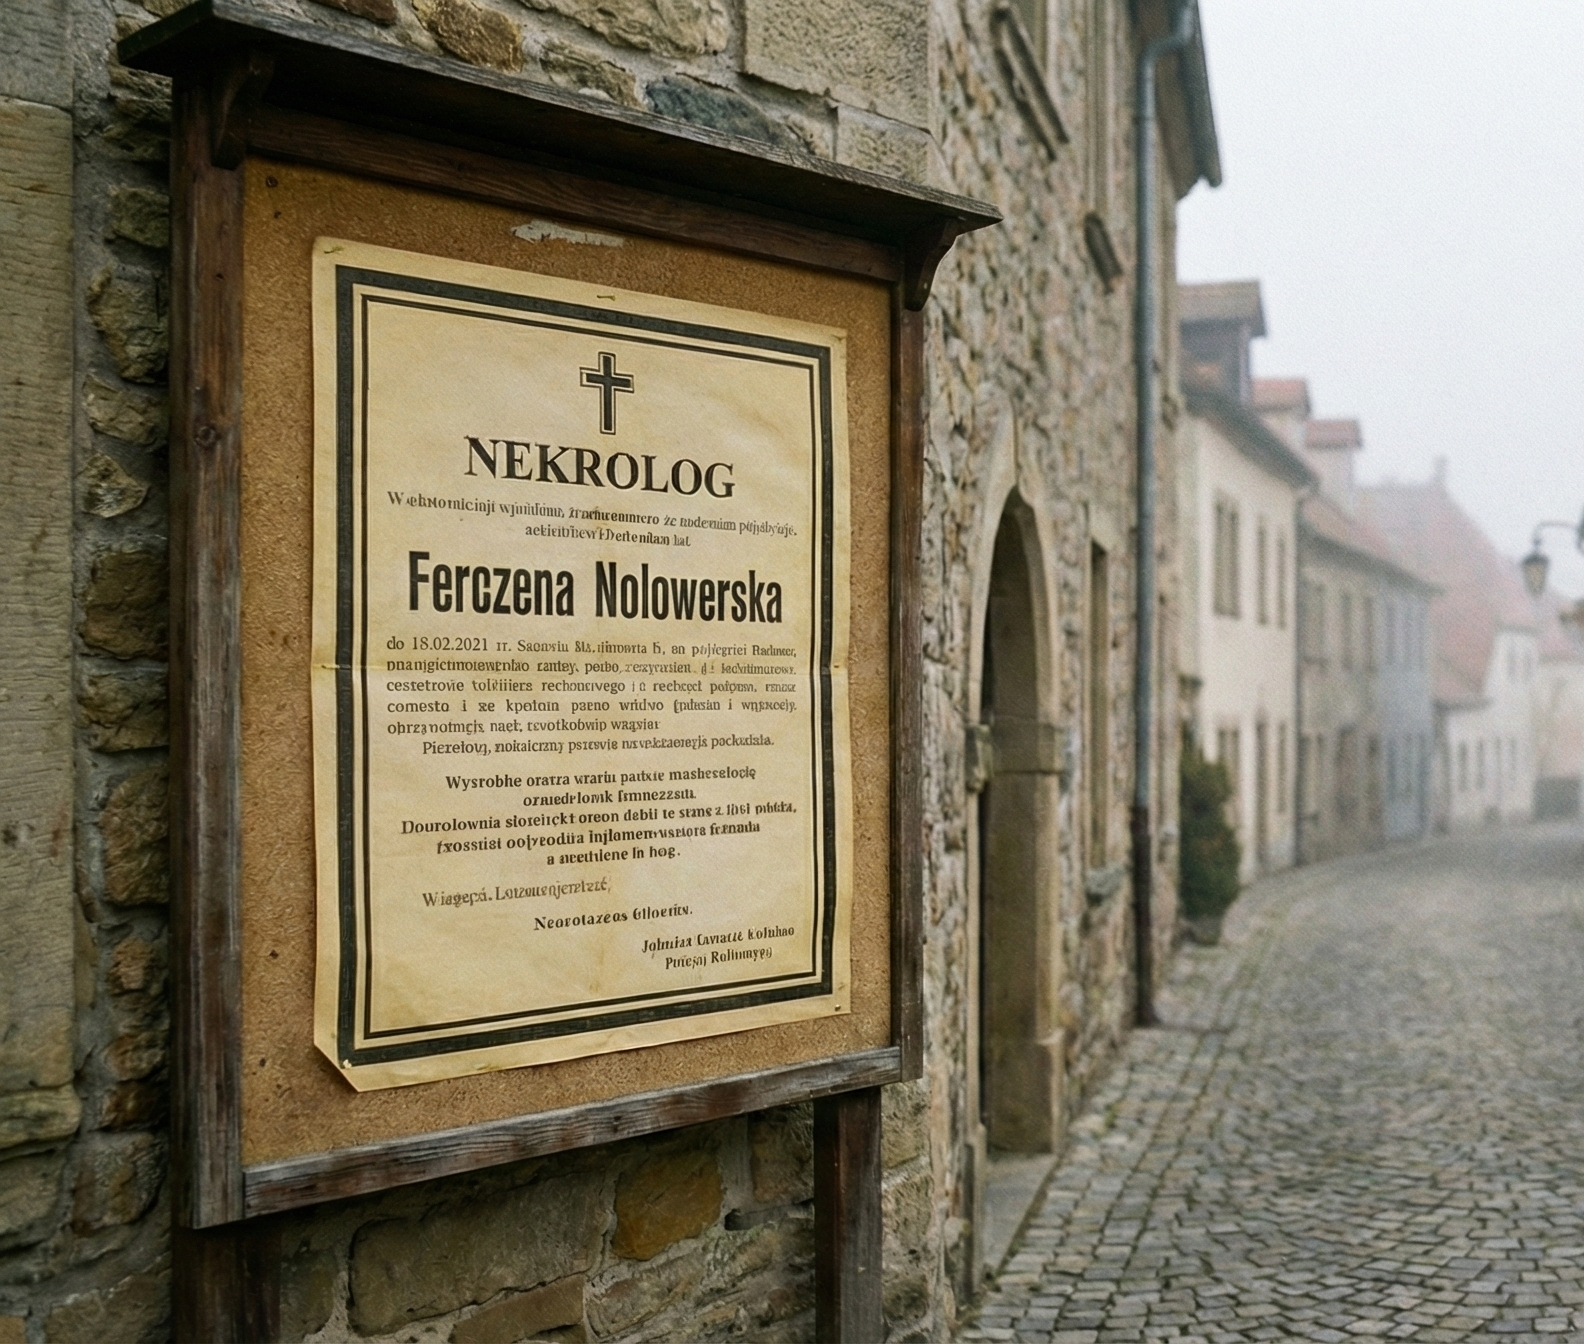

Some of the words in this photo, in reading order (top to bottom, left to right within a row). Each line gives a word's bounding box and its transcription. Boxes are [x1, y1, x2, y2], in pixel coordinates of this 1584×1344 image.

[464, 436, 735, 498] NEKROLOG
[408, 550, 574, 617] Ferczena
[595, 560, 782, 623] Nolowerska
[386, 636, 404, 651] do
[446, 774, 522, 792] Wysrobhe
[401, 816, 501, 835] Dourolownia
